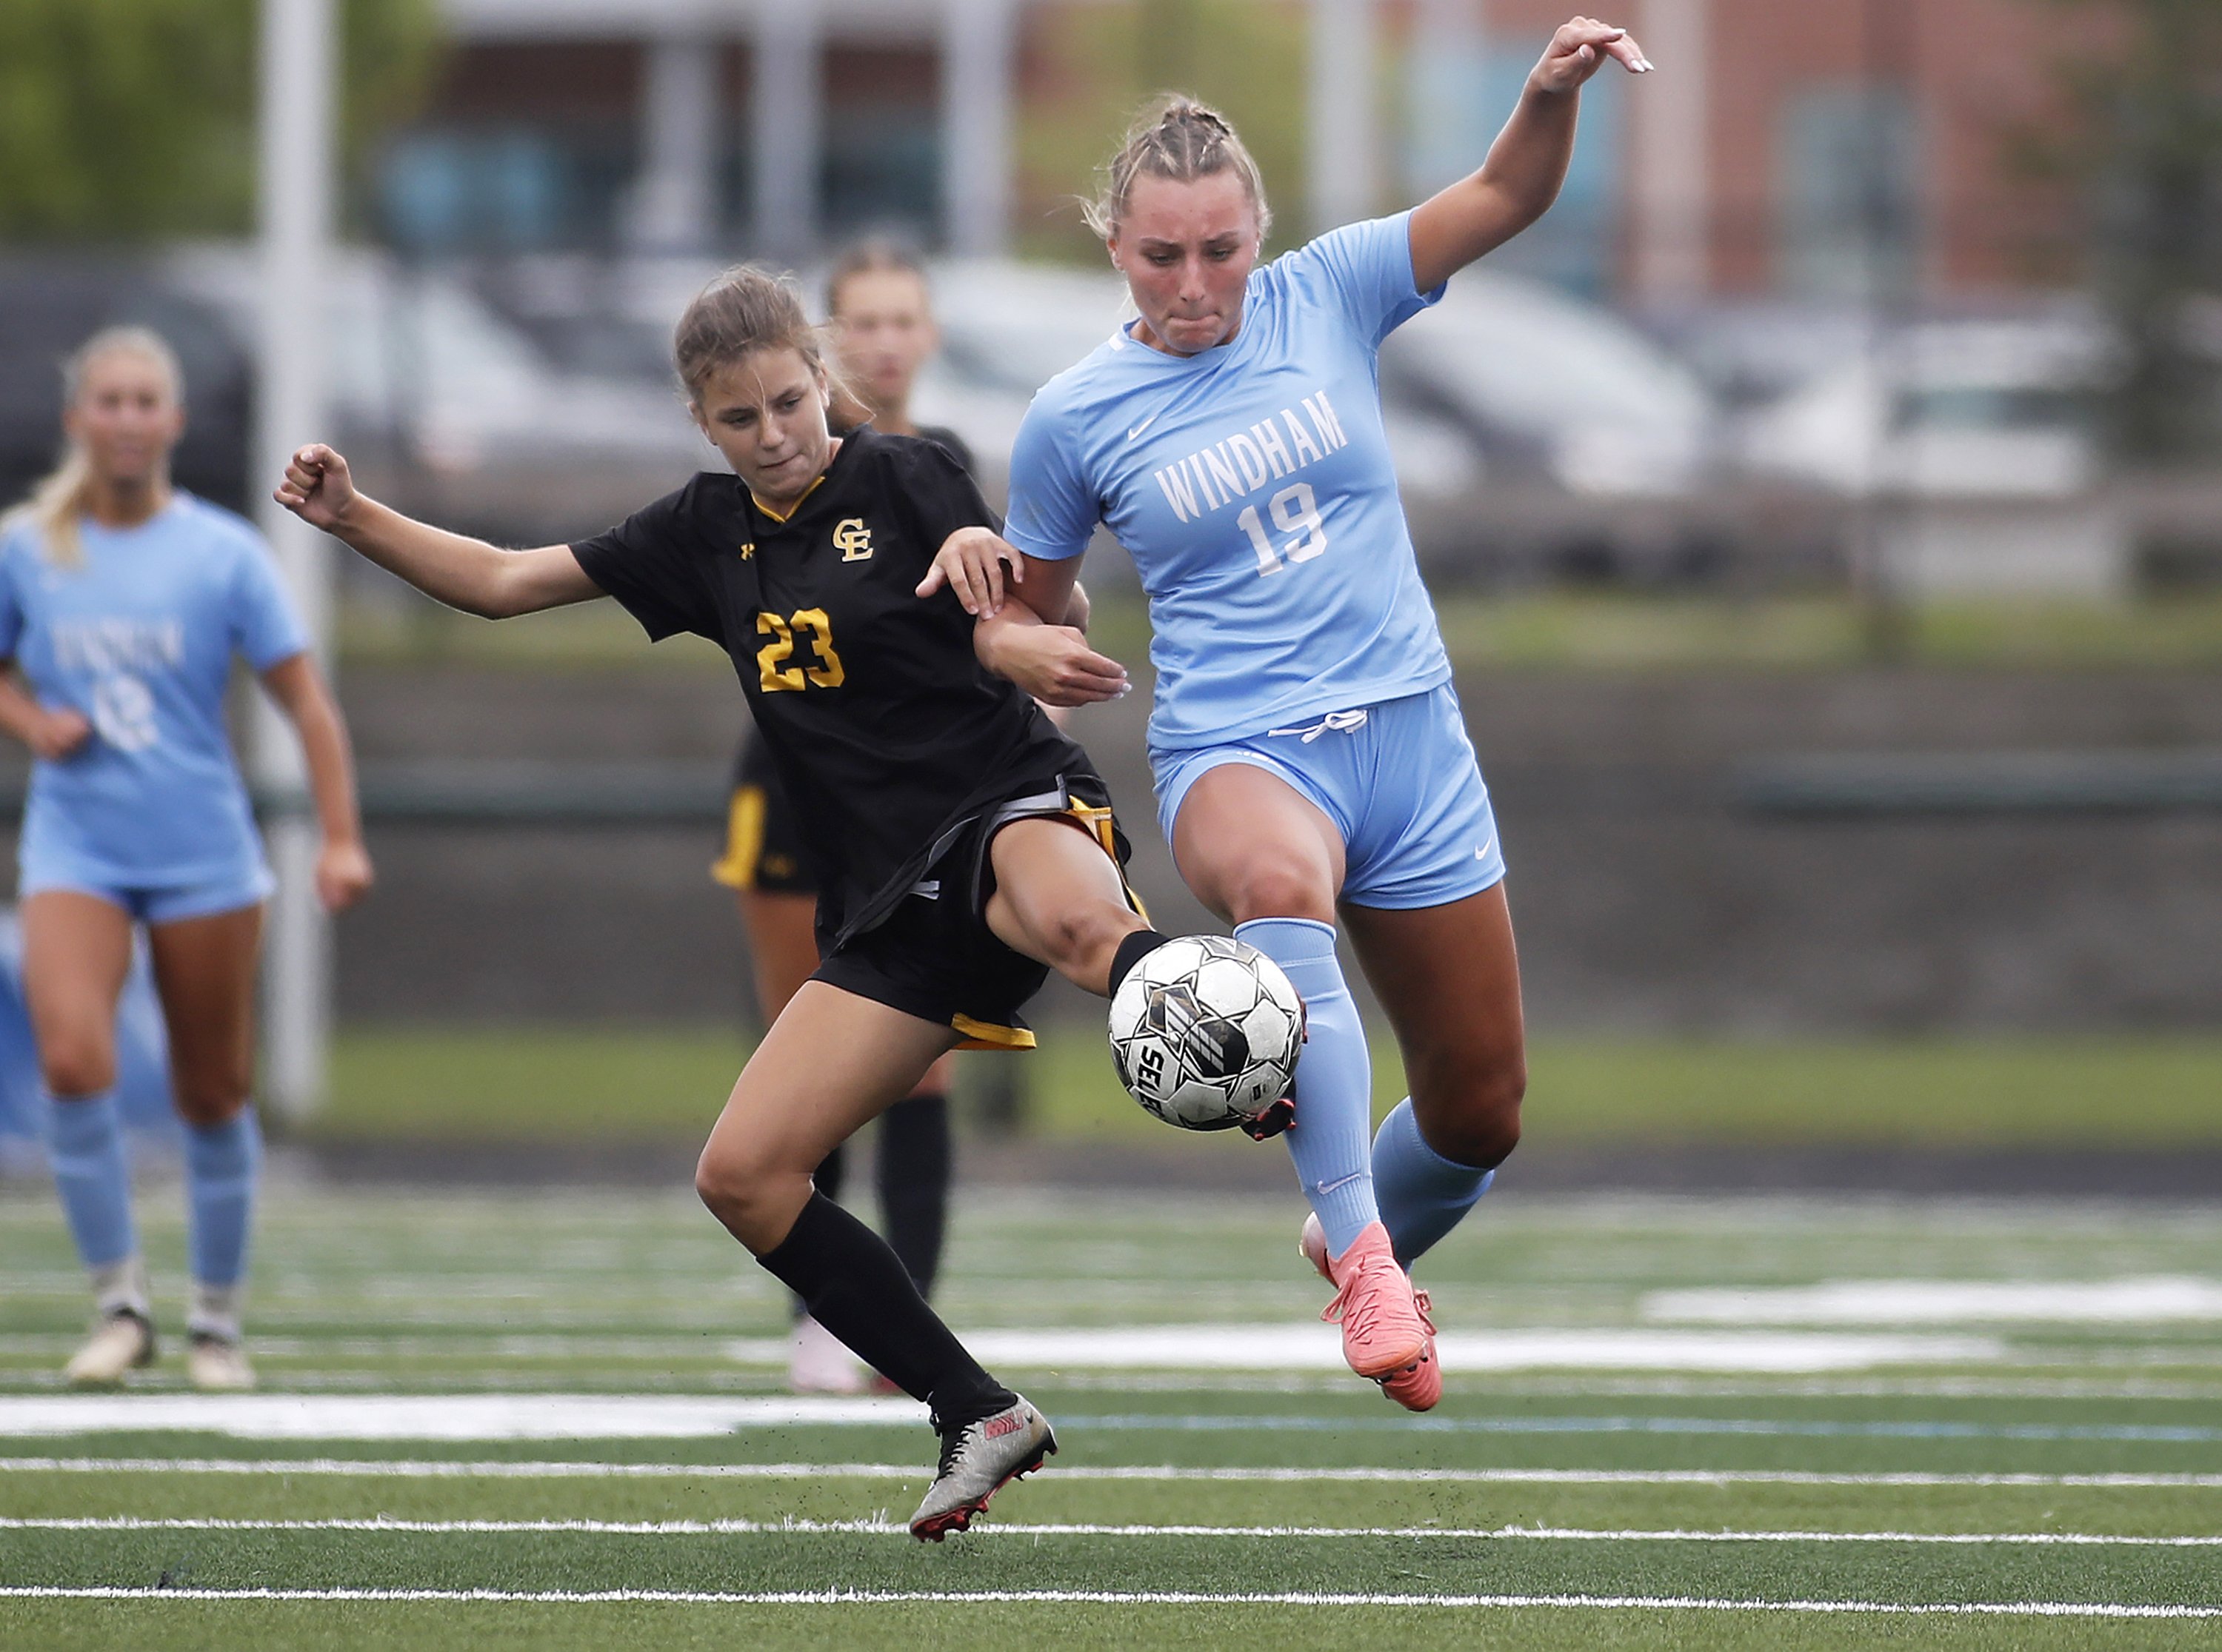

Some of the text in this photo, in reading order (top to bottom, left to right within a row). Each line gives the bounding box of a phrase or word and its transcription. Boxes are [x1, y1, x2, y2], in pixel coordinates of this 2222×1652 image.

[1154, 390, 1348, 524] WINDHAM
[833, 518, 874, 562] CE
[1236, 482, 1328, 578] 19
[756, 608, 845, 692] 23
